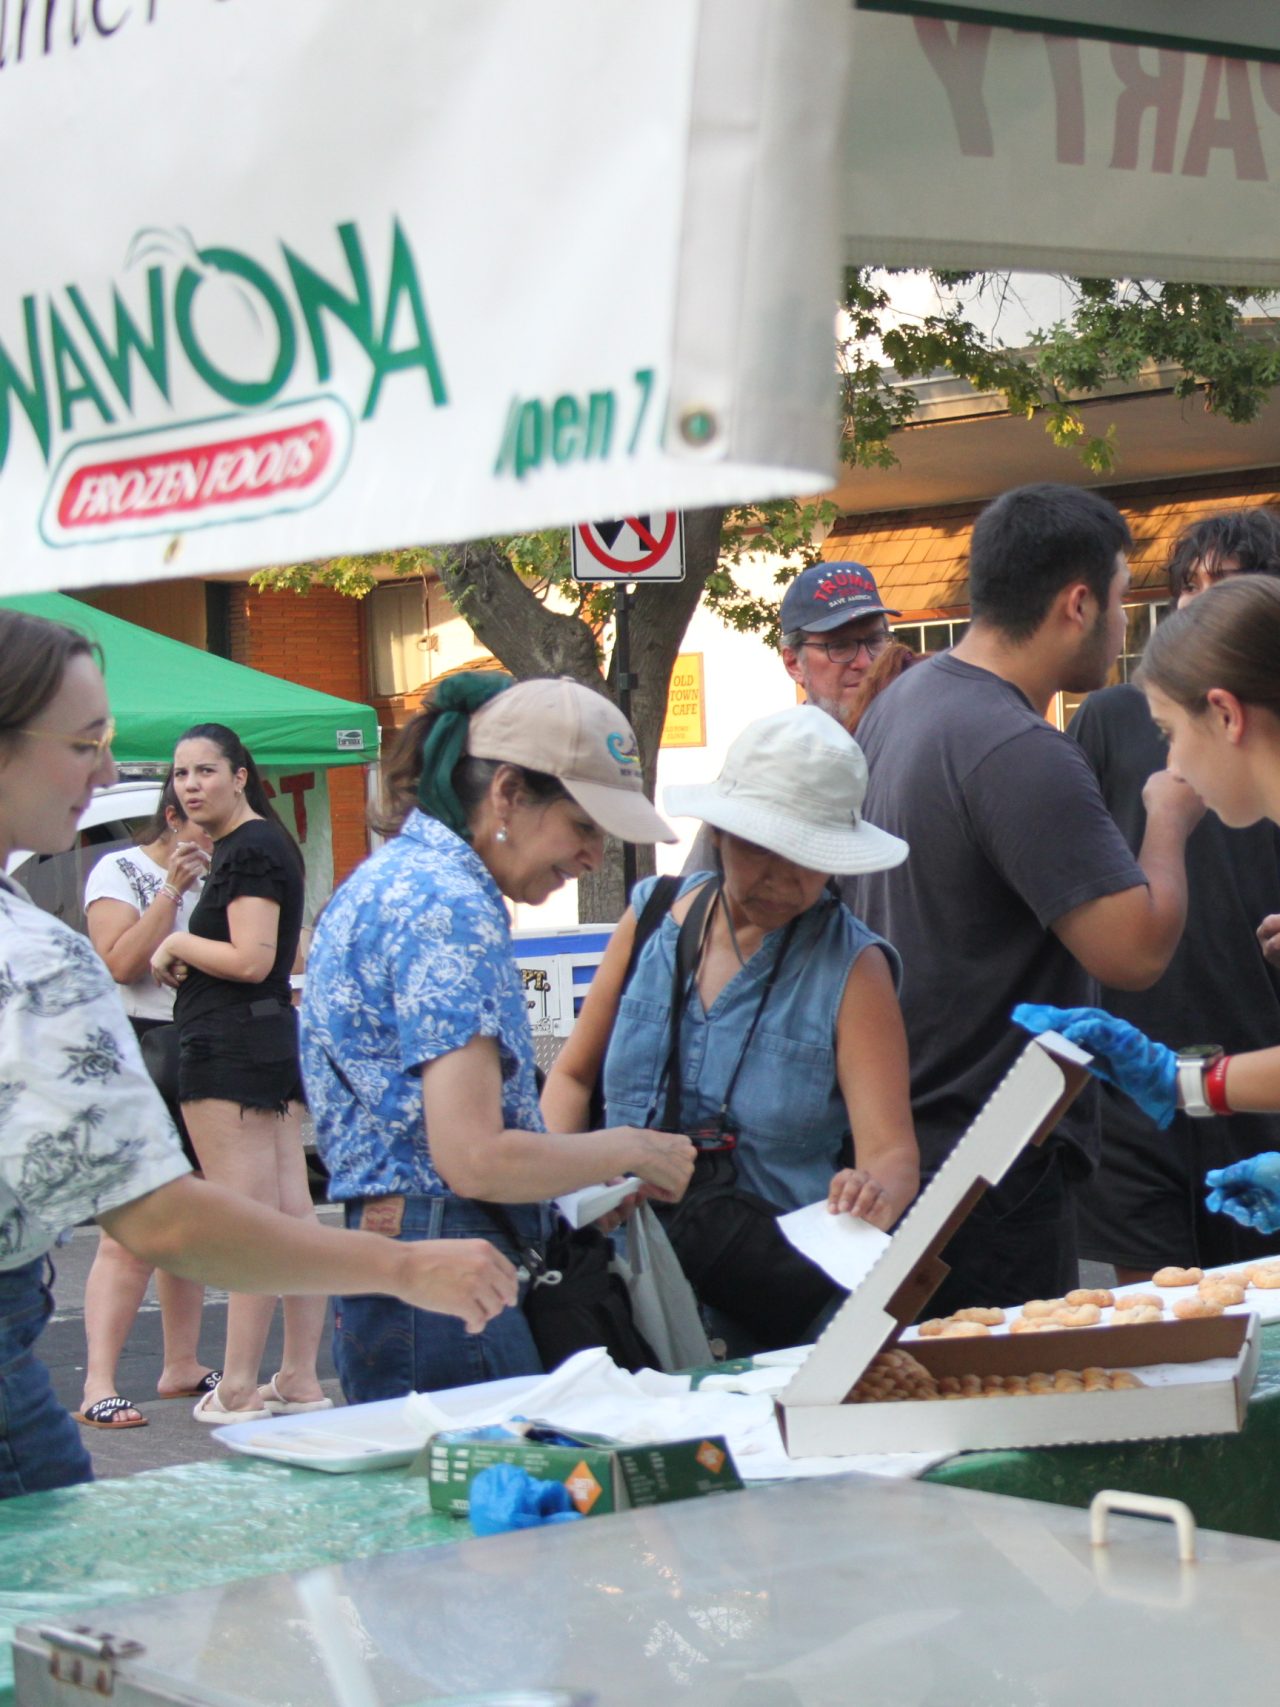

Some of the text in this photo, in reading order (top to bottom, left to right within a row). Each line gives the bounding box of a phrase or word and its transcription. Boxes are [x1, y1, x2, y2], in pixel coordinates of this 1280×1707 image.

[494, 390, 617, 482] pen
[69, 429, 321, 519] FROZEN FOODS
[812, 574, 876, 602] TRUMP
[828, 598, 846, 608] SAVE
[673, 675, 694, 687] OLD
[670, 688, 699, 702] TOWN
[672, 703, 698, 716] CAFE
